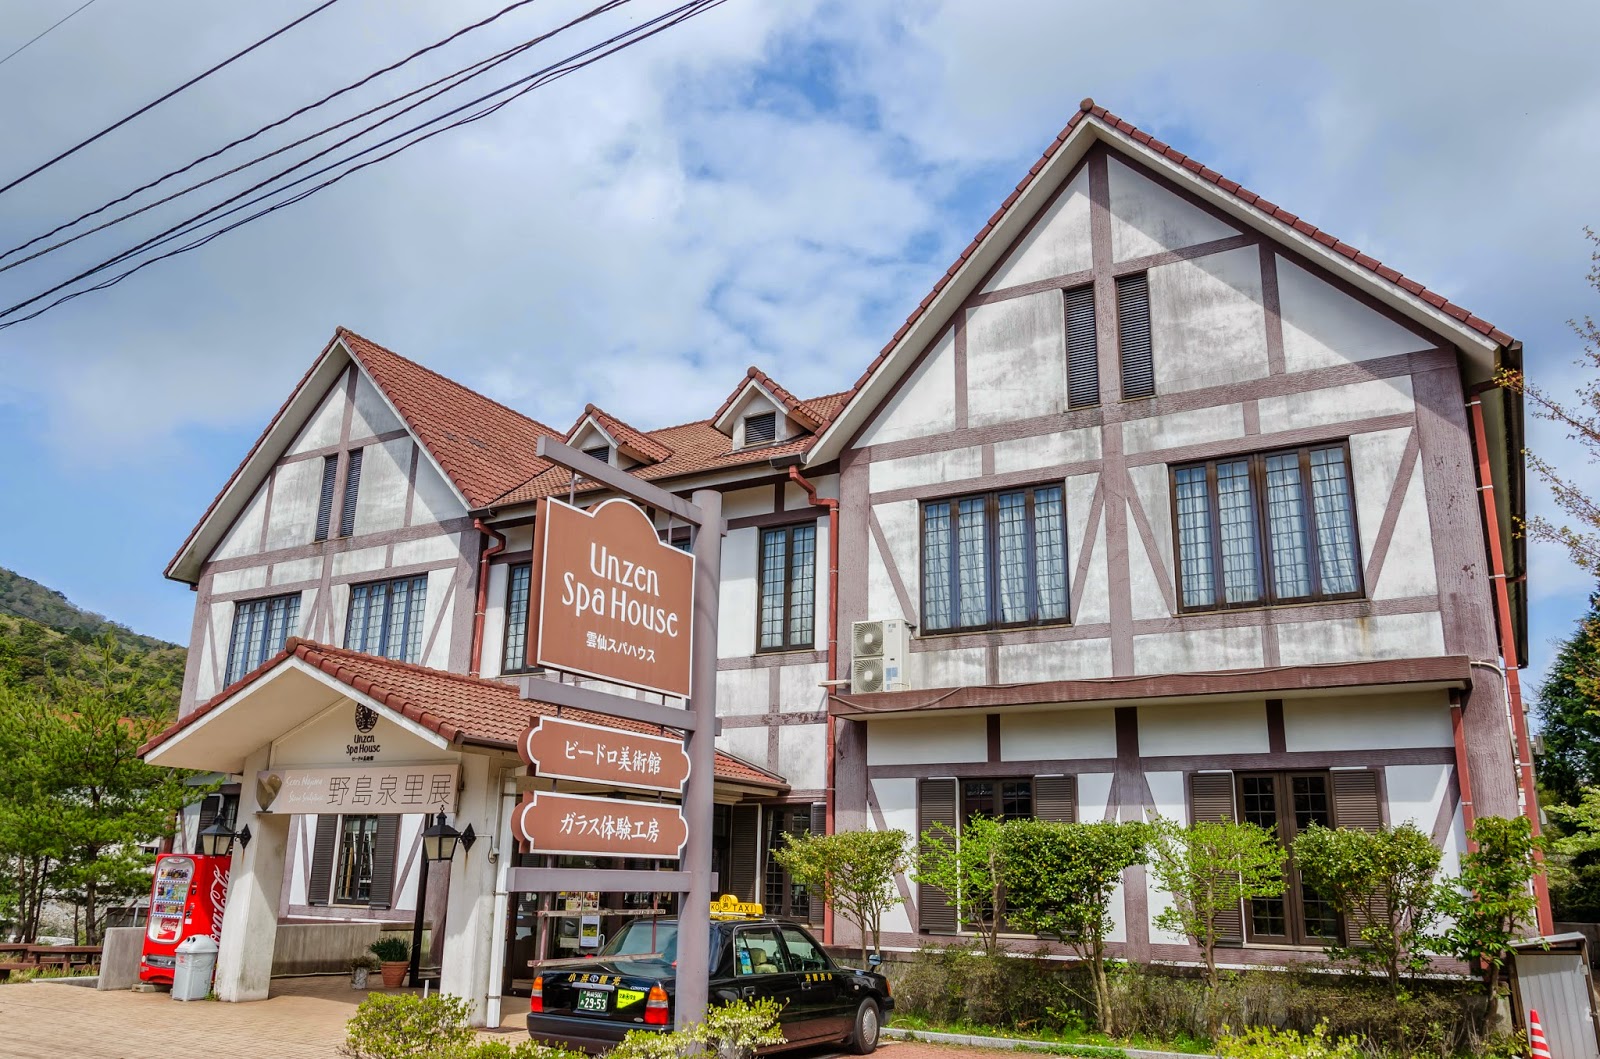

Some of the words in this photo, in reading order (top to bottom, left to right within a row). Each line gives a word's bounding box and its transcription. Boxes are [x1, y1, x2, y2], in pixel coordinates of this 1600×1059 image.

[590, 542, 660, 597] Unzen
[562, 572, 605, 617] Spa
[611, 587, 678, 637] House
[586, 631, 656, 663] 雲仙スパハウス
[346, 744, 358, 756] Spa
[359, 744, 381, 753] House
[354, 734, 375, 744] Unzen
[564, 740, 662, 775] ビードロ美術館
[326, 774, 452, 806] 野島泉里展
[559, 811, 660, 843] ガラス体験工房
[732, 904, 753, 912] TAXI
[584, 997, 606, 1010] 29-53
